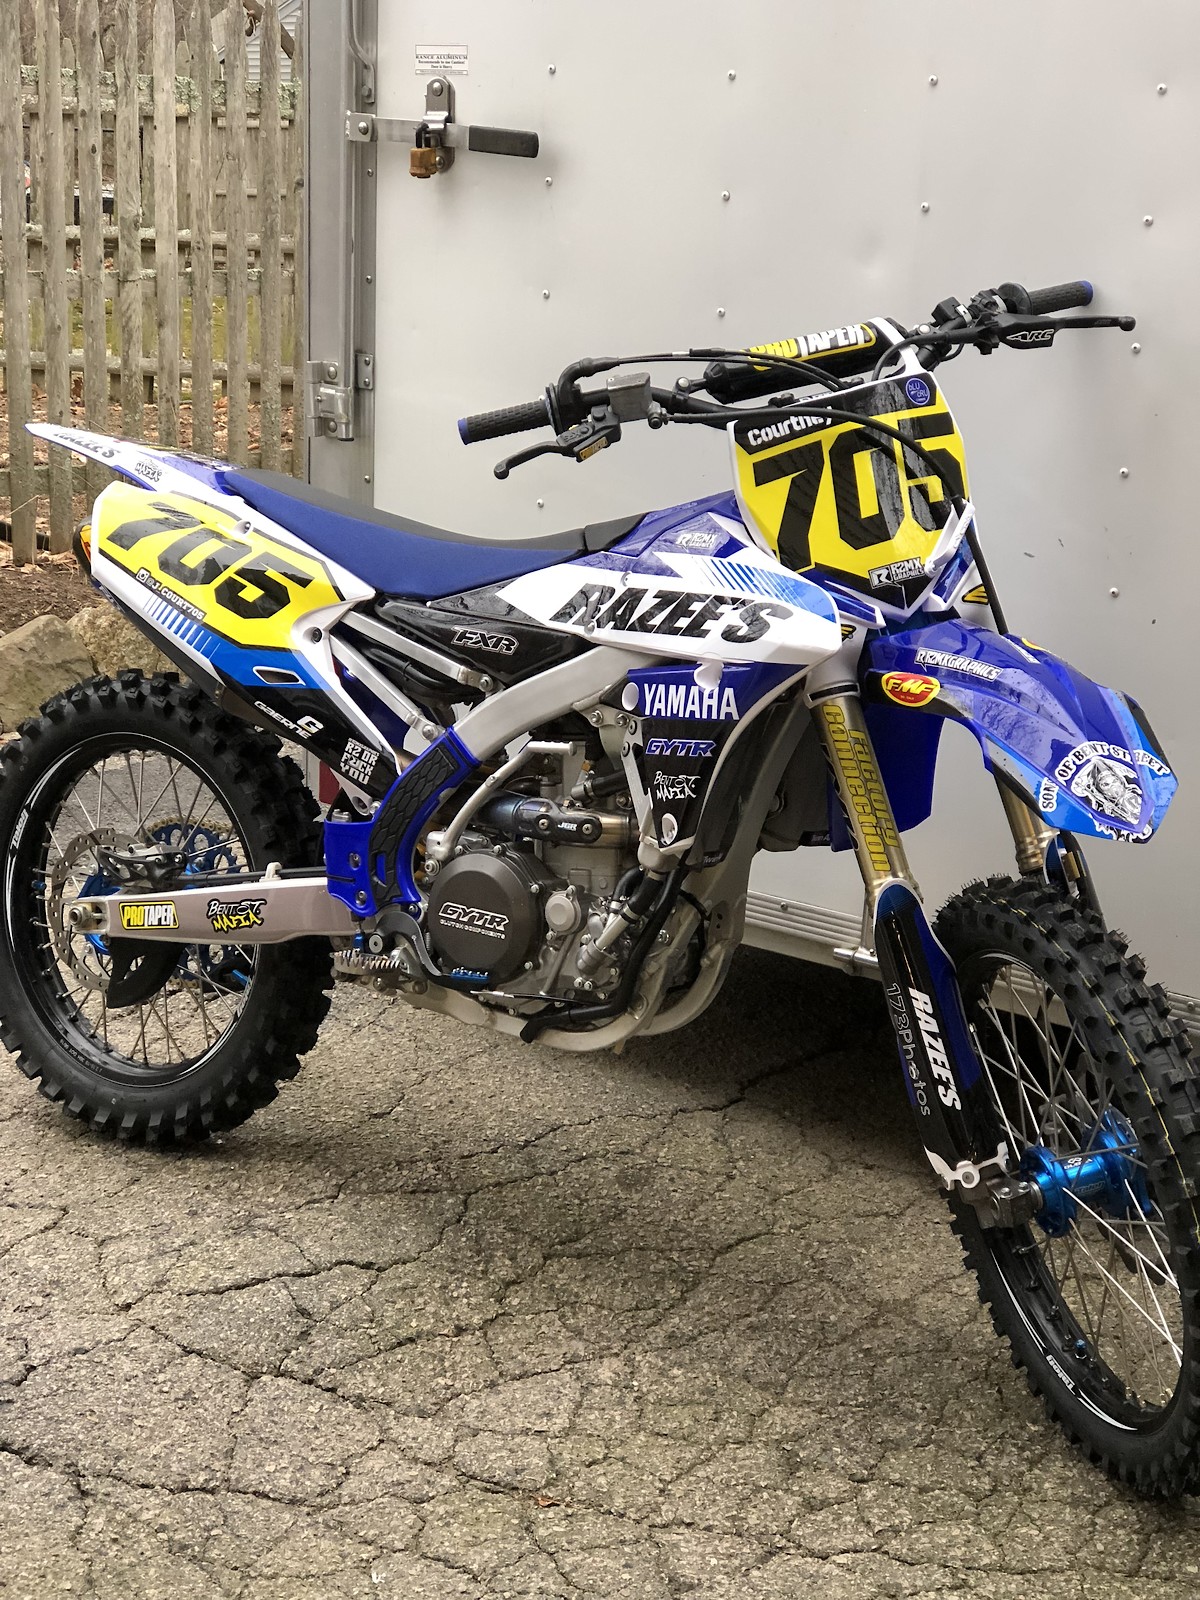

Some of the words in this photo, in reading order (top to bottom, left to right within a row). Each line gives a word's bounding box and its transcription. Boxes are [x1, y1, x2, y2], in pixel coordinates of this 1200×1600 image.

[1006, 329, 1055, 342] ARC
[753, 411, 965, 571] 705
[106, 501, 315, 620] 705
[549, 583, 794, 643] RAZEE'S
[453, 627, 518, 654] FXR
[886, 678, 938, 694] FMF
[643, 682, 740, 720] YAMAHA
[361, 750, 378, 766] OR
[645, 738, 716, 757] GYTR
[340, 761, 370, 785] YOU
[1058, 761, 1073, 778] OF
[1073, 743, 1108, 762] BENT
[124, 904, 174, 927] PROTAPER
[213, 911, 262, 932] MAFIA
[438, 901, 509, 931] GYTR
[440, 918, 464, 930] CLUTCH
[908, 986, 962, 1111] RAZEE'S
